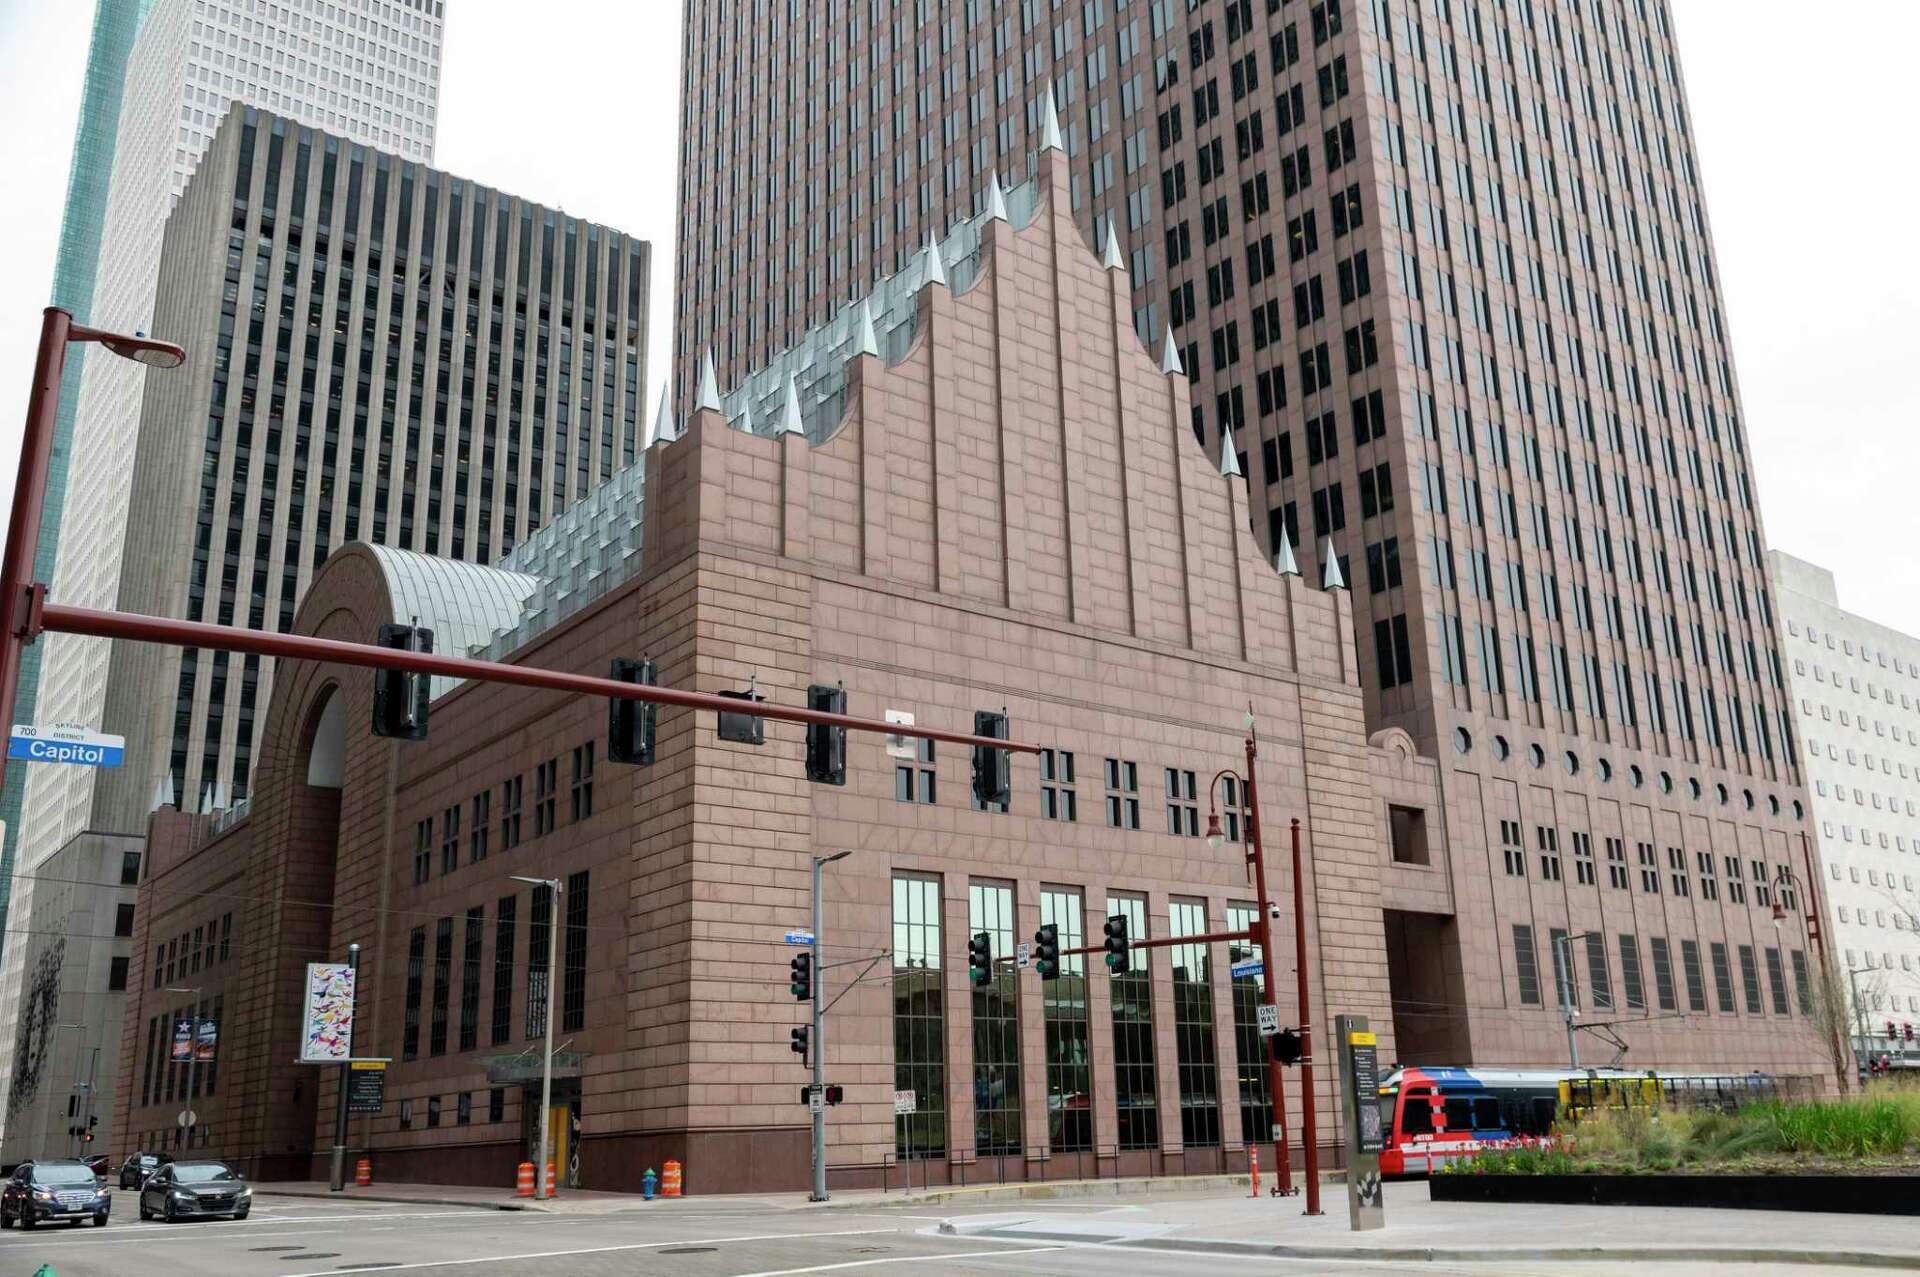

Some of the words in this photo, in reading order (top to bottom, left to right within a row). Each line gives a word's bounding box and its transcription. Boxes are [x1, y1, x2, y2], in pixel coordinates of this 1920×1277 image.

[20, 727, 37, 736] 700
[53, 732, 84, 740] DISTRICT
[30, 741, 104, 763] Capitol
[1233, 967, 1263, 977] Louisiana
[1260, 1007, 1276, 1016] ONE
[1260, 1015, 1277, 1023] WAY
